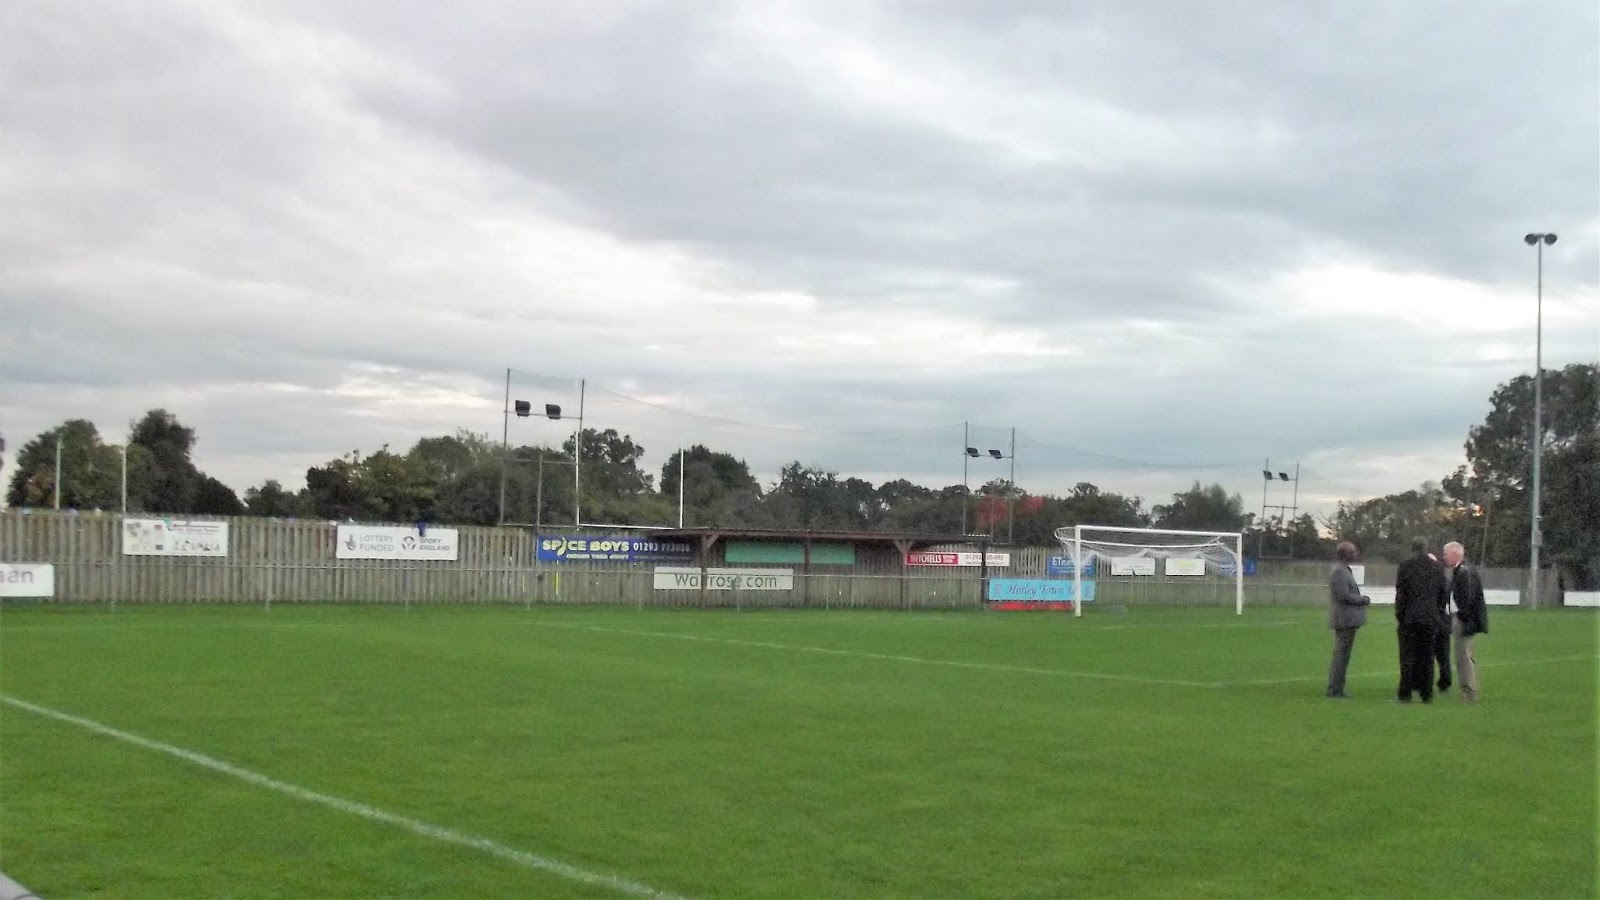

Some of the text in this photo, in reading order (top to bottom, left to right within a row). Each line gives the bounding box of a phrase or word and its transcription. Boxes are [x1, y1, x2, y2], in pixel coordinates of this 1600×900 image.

[360, 534, 394, 542] LOTTERY
[360, 544, 394, 552] FUNDED
[542, 537, 587, 555] SPICE
[590, 540, 630, 552] BOYS
[633, 542, 659, 552] 01293
[674, 573, 777, 588] Warose.com
